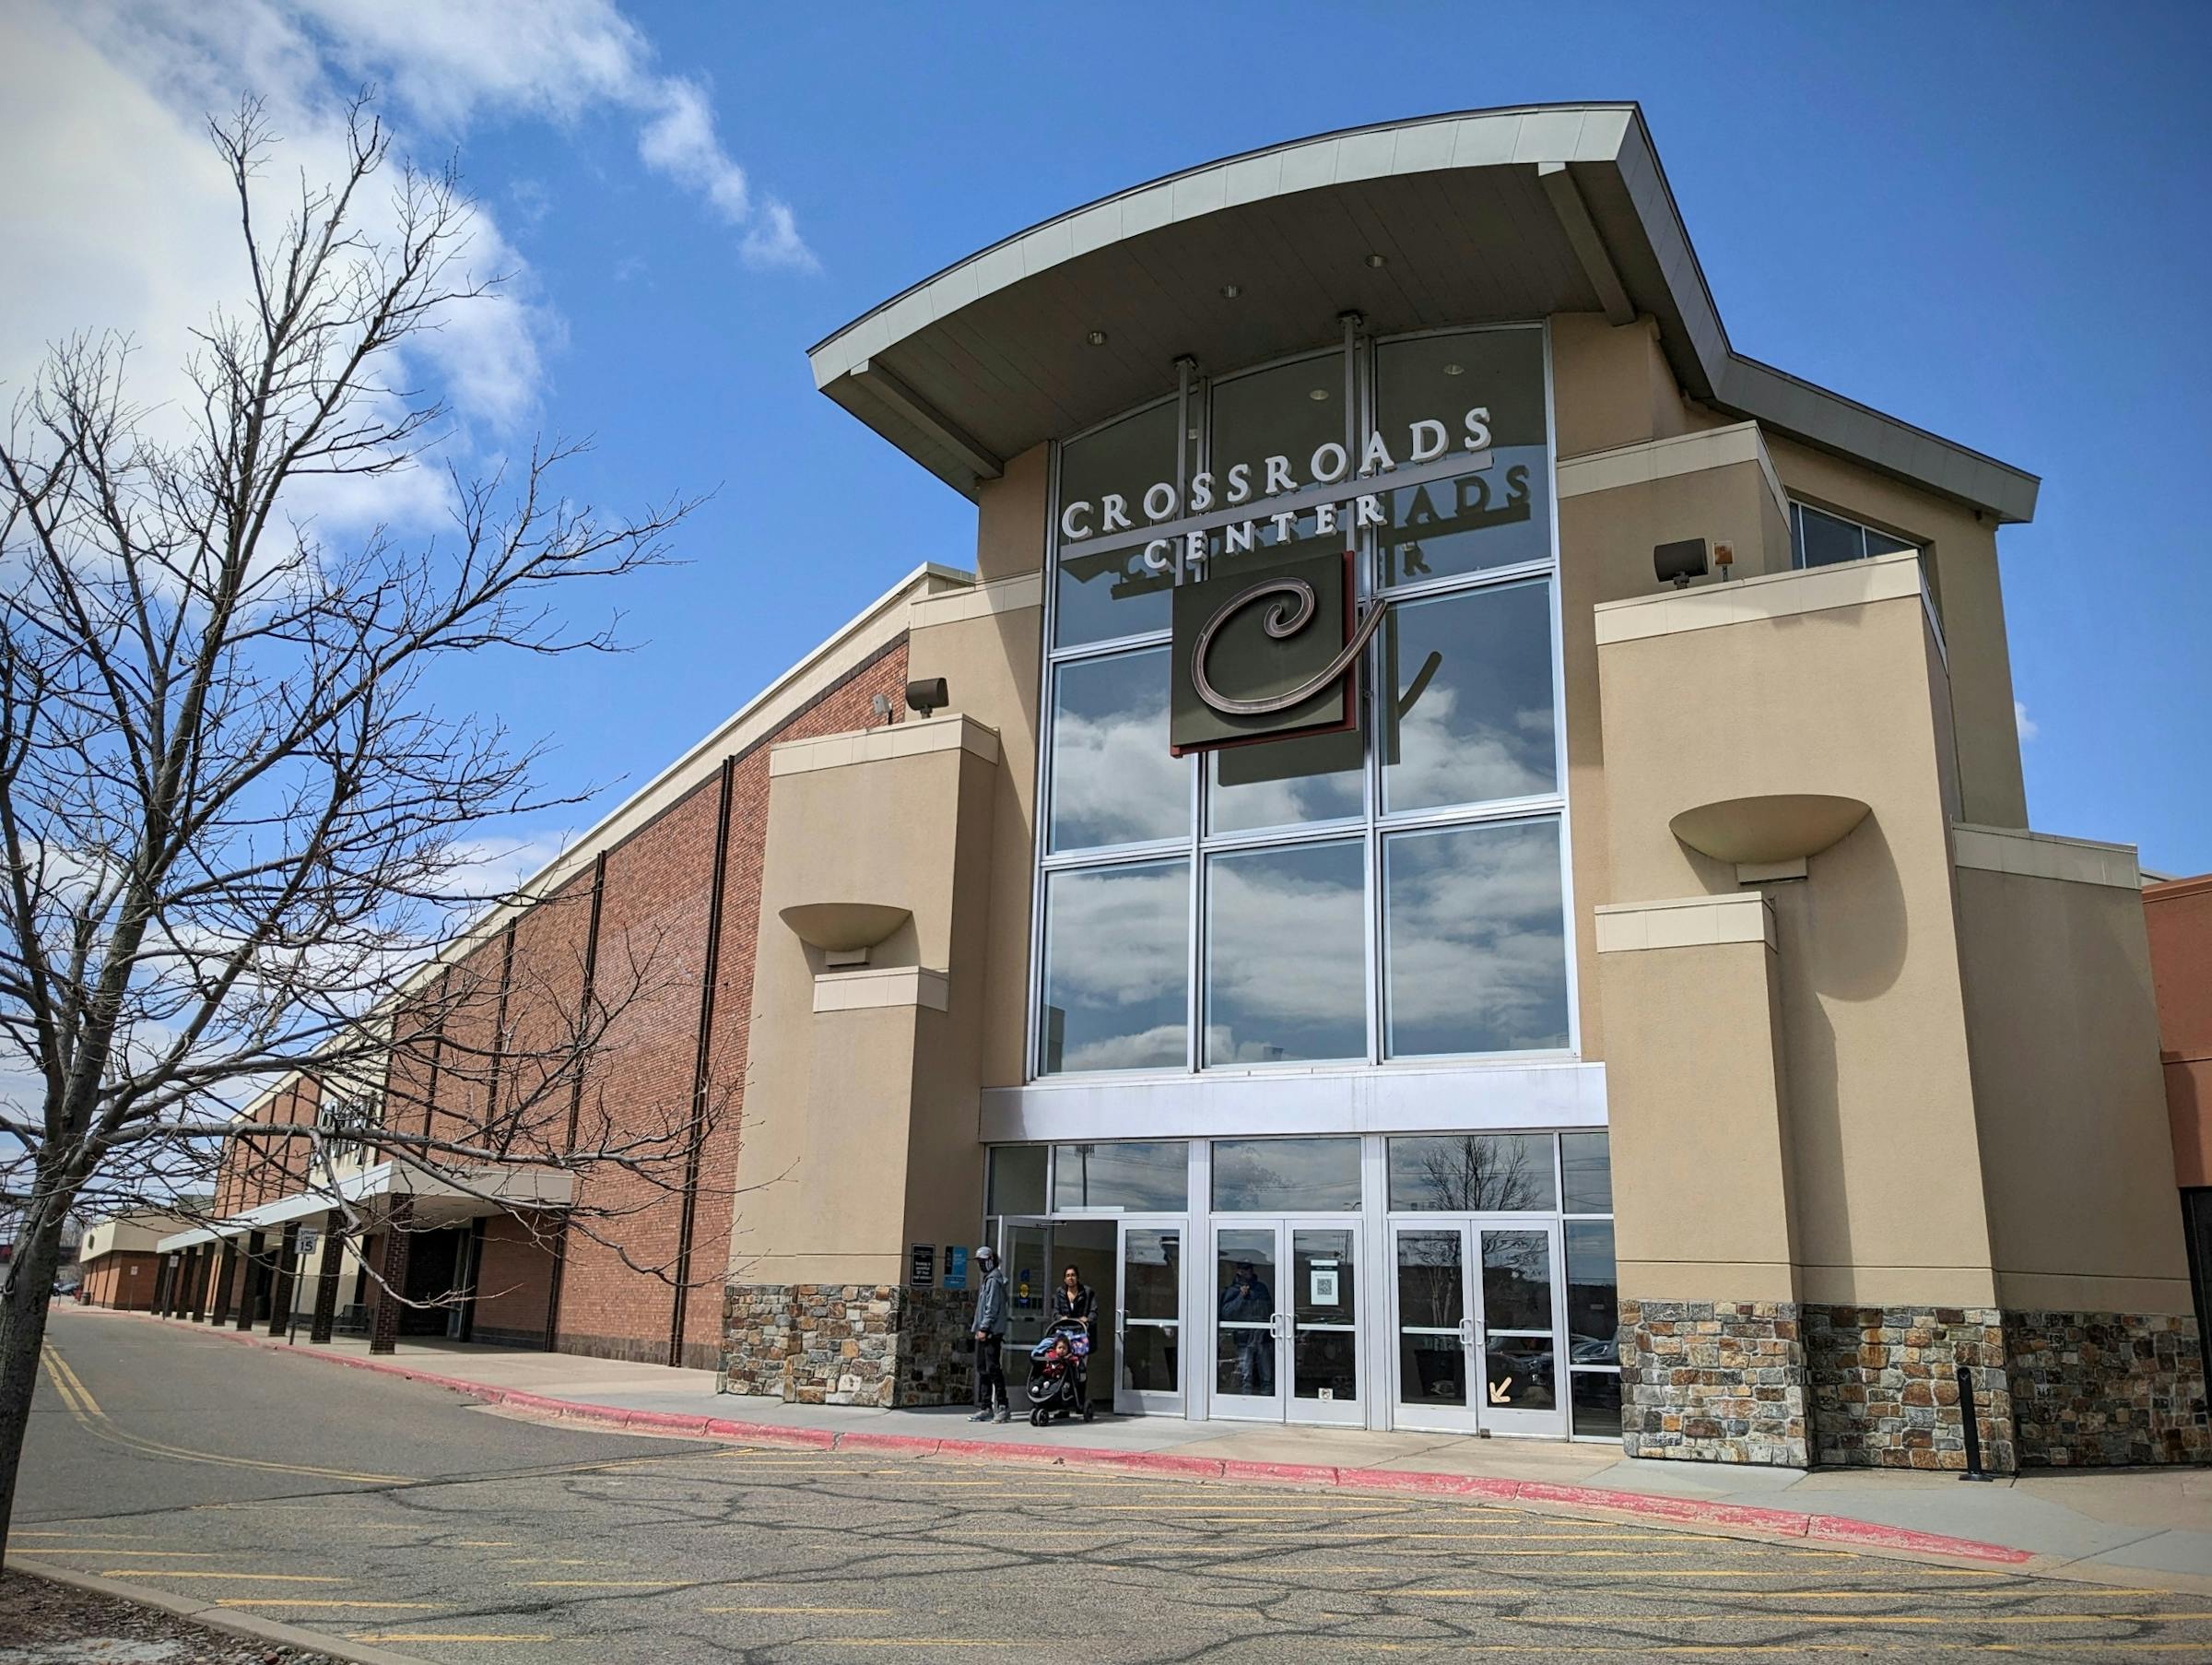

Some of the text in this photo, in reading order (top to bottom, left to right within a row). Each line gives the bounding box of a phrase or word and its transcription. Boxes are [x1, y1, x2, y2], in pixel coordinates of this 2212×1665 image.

[1061, 407, 1493, 540] CROSSROADS
[1144, 495, 1388, 570] CENTER
[300, 1241, 313, 1252] 15
